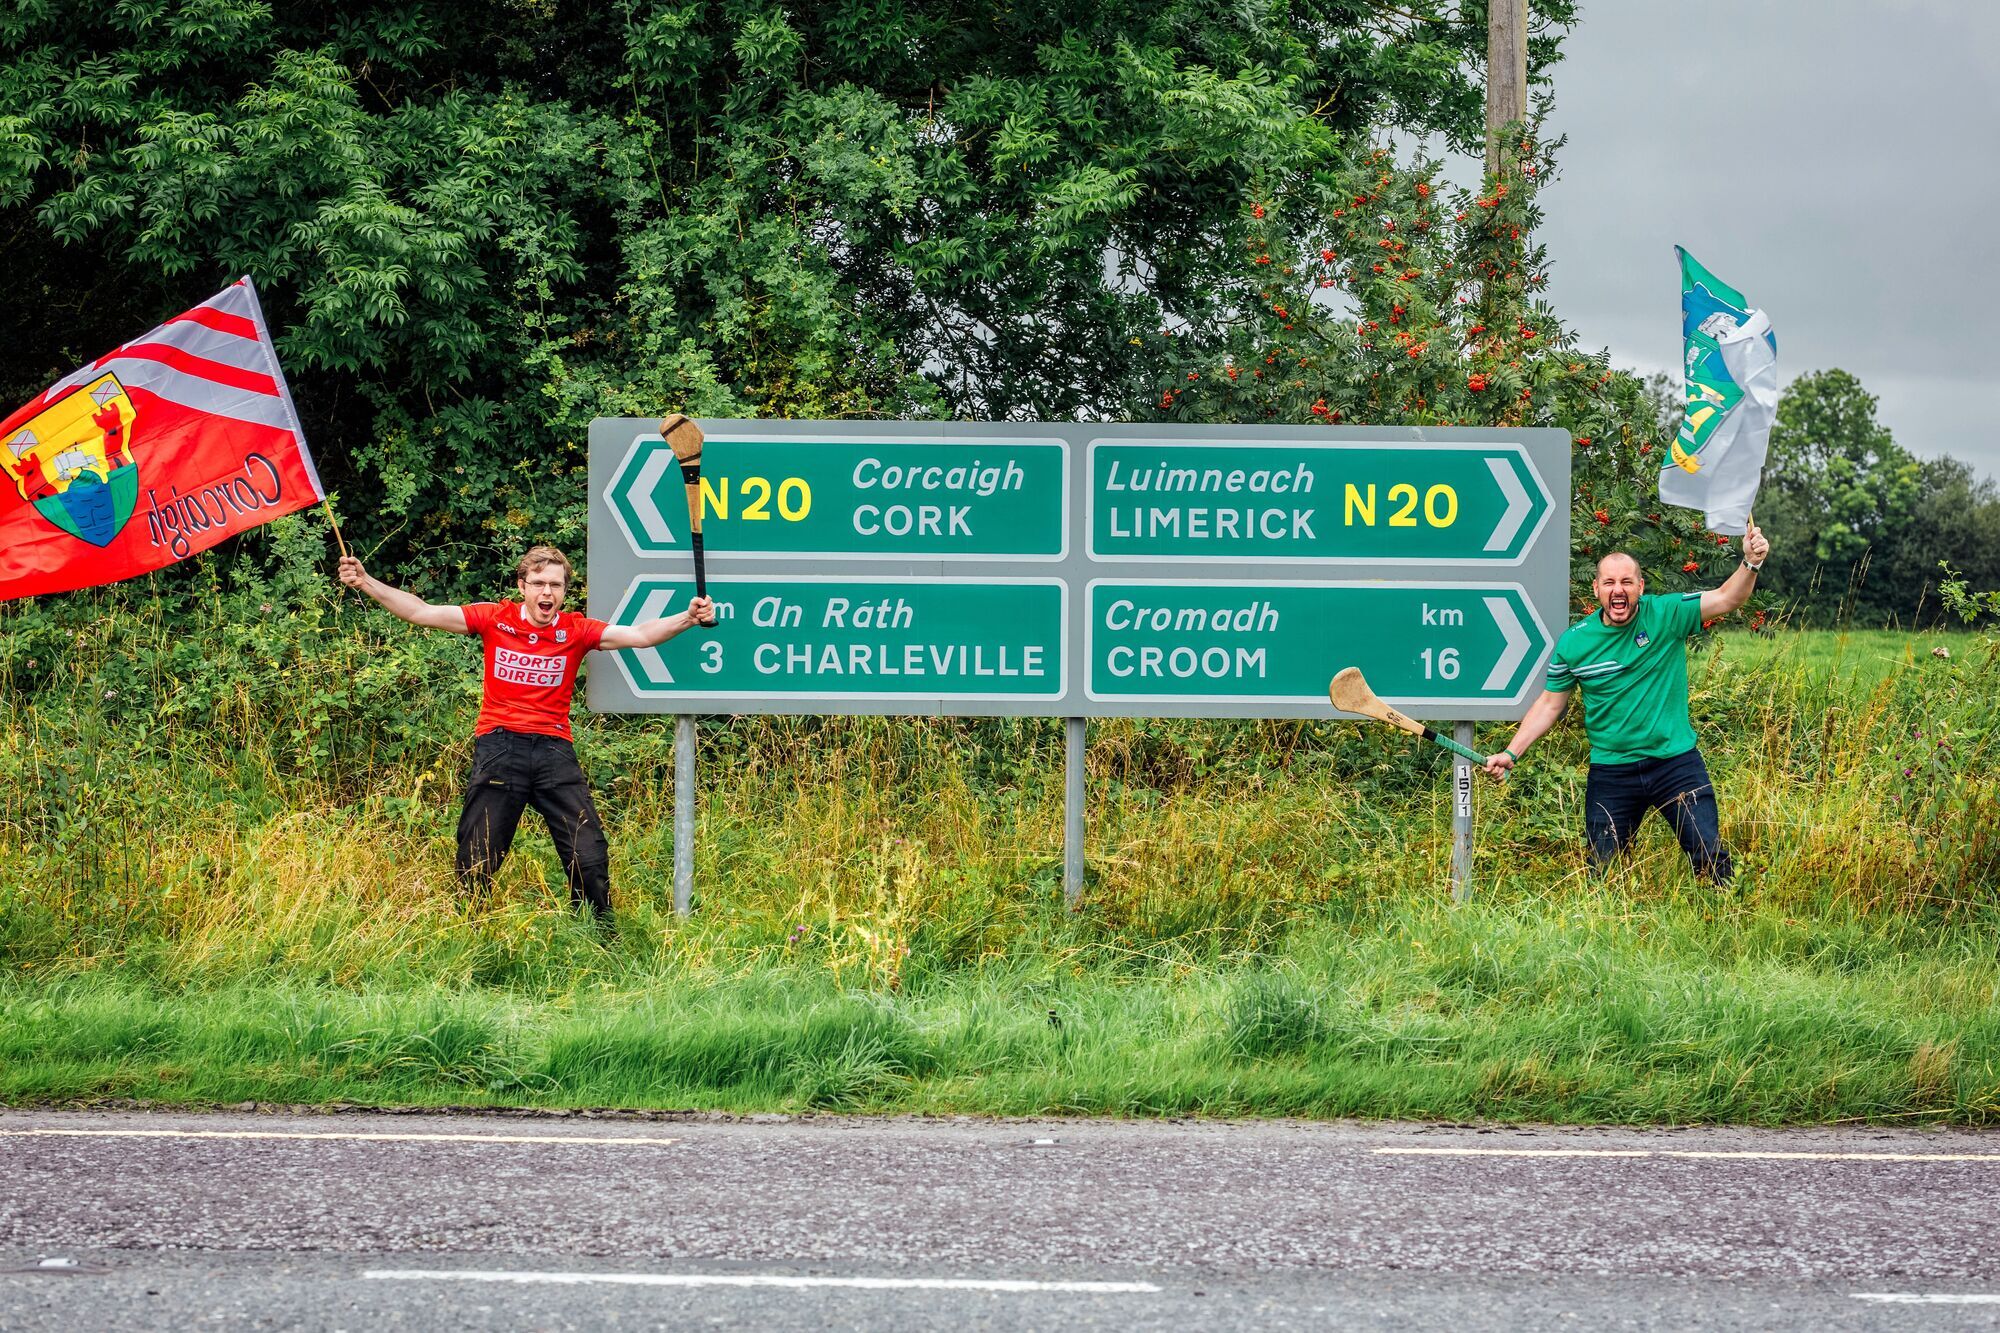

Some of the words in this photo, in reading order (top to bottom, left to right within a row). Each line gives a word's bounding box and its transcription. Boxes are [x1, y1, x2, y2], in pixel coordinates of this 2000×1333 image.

[852, 458, 1024, 496] Corcaigh
[1106, 460, 1314, 492] Luimneach
[699, 476, 812, 522] N20
[1344, 483, 1459, 528] N20
[852, 504, 973, 536] CORK
[1110, 507, 1316, 540] LIMERICK
[497, 622, 516, 635] GAA
[752, 597, 803, 628] An
[822, 597, 914, 629] Ráth
[1105, 599, 1279, 632] Cromadh
[1422, 602, 1464, 626] km
[528, 633, 539, 645] 9
[499, 650, 562, 670] SPORTS
[700, 640, 723, 674] 3
[753, 643, 1045, 676] CHARLEVILLE
[1105, 645, 1266, 678] CROOM
[1420, 647, 1461, 680] 16
[497, 667, 560, 685] DIRECT
